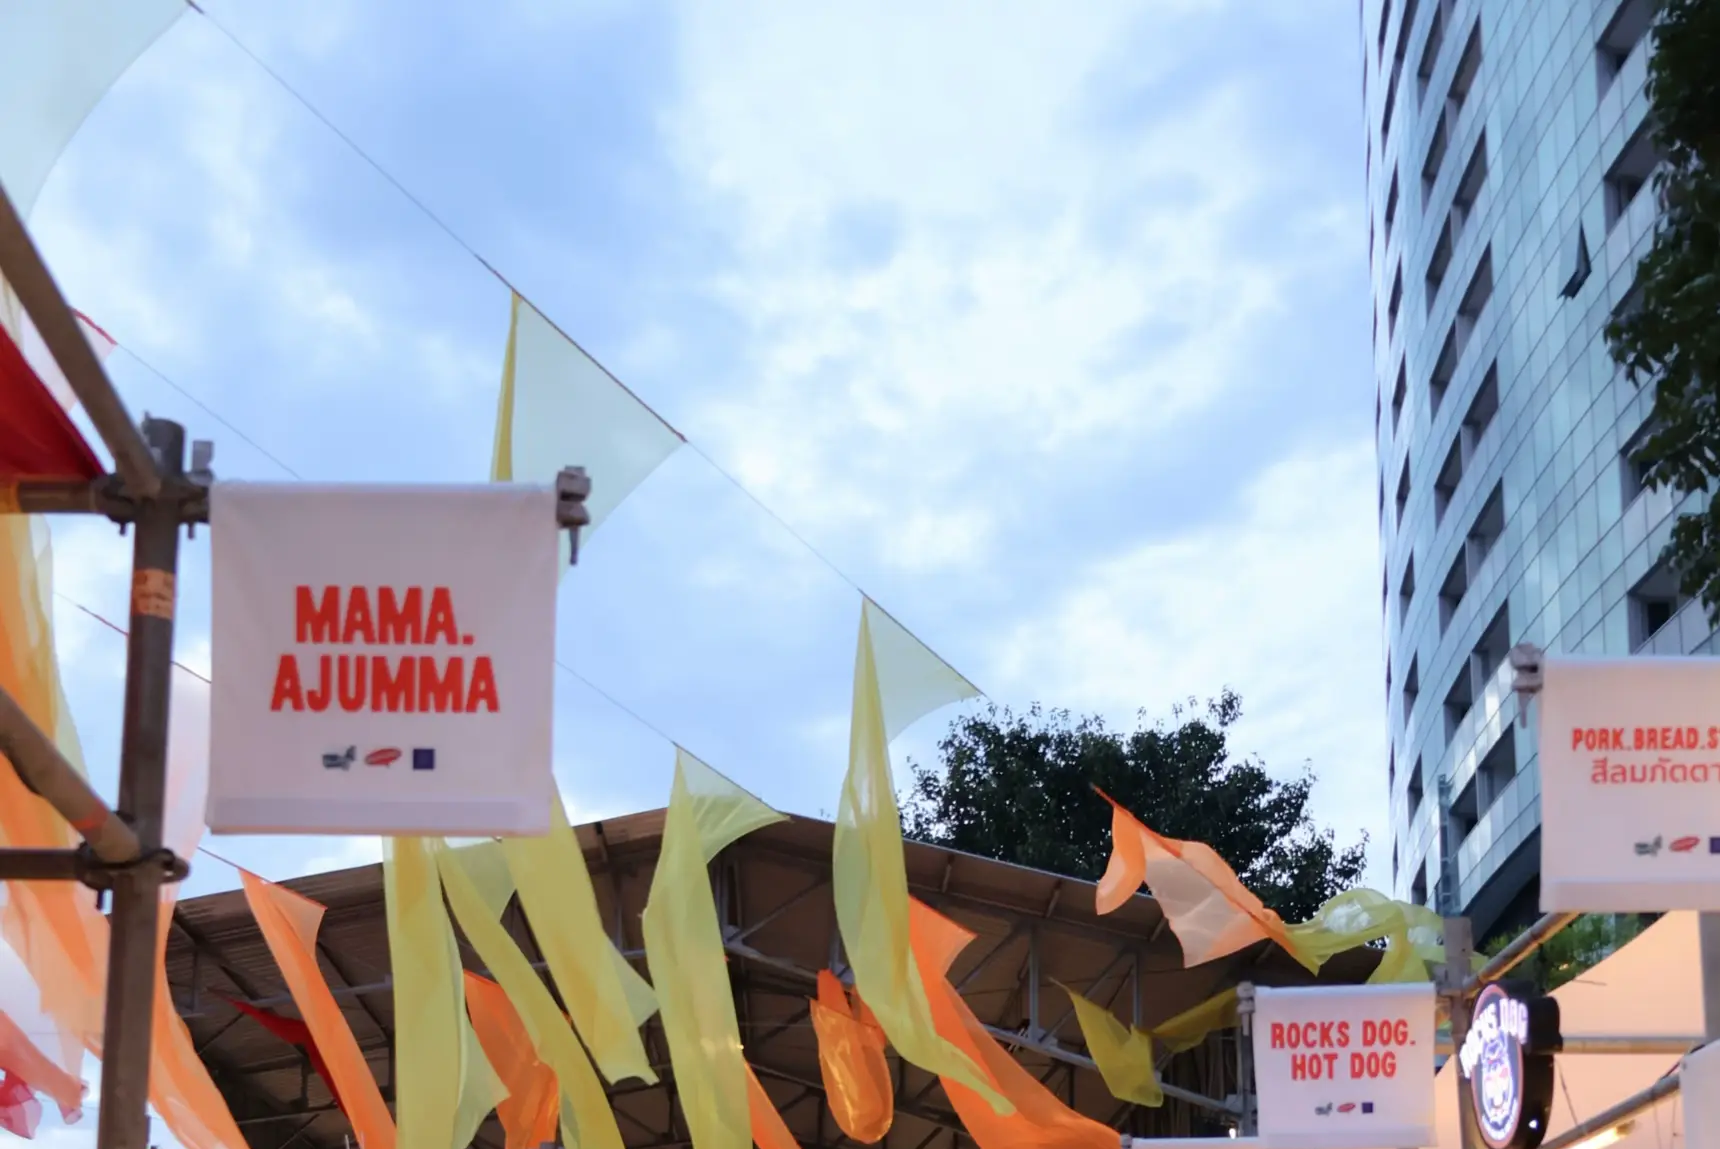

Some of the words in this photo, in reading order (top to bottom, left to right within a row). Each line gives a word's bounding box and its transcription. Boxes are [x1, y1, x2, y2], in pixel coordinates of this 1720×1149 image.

[296, 585, 474, 645] MAMA.
[270, 654, 499, 713] AJUMMA
[1572, 727, 1720, 751] PORK.BREAD.S
[1270, 1020, 1350, 1049] ROCKS
[1362, 1019, 1416, 1047] DOG.
[1291, 1053, 1338, 1080] HOT
[1350, 1051, 1397, 1079] DOG
